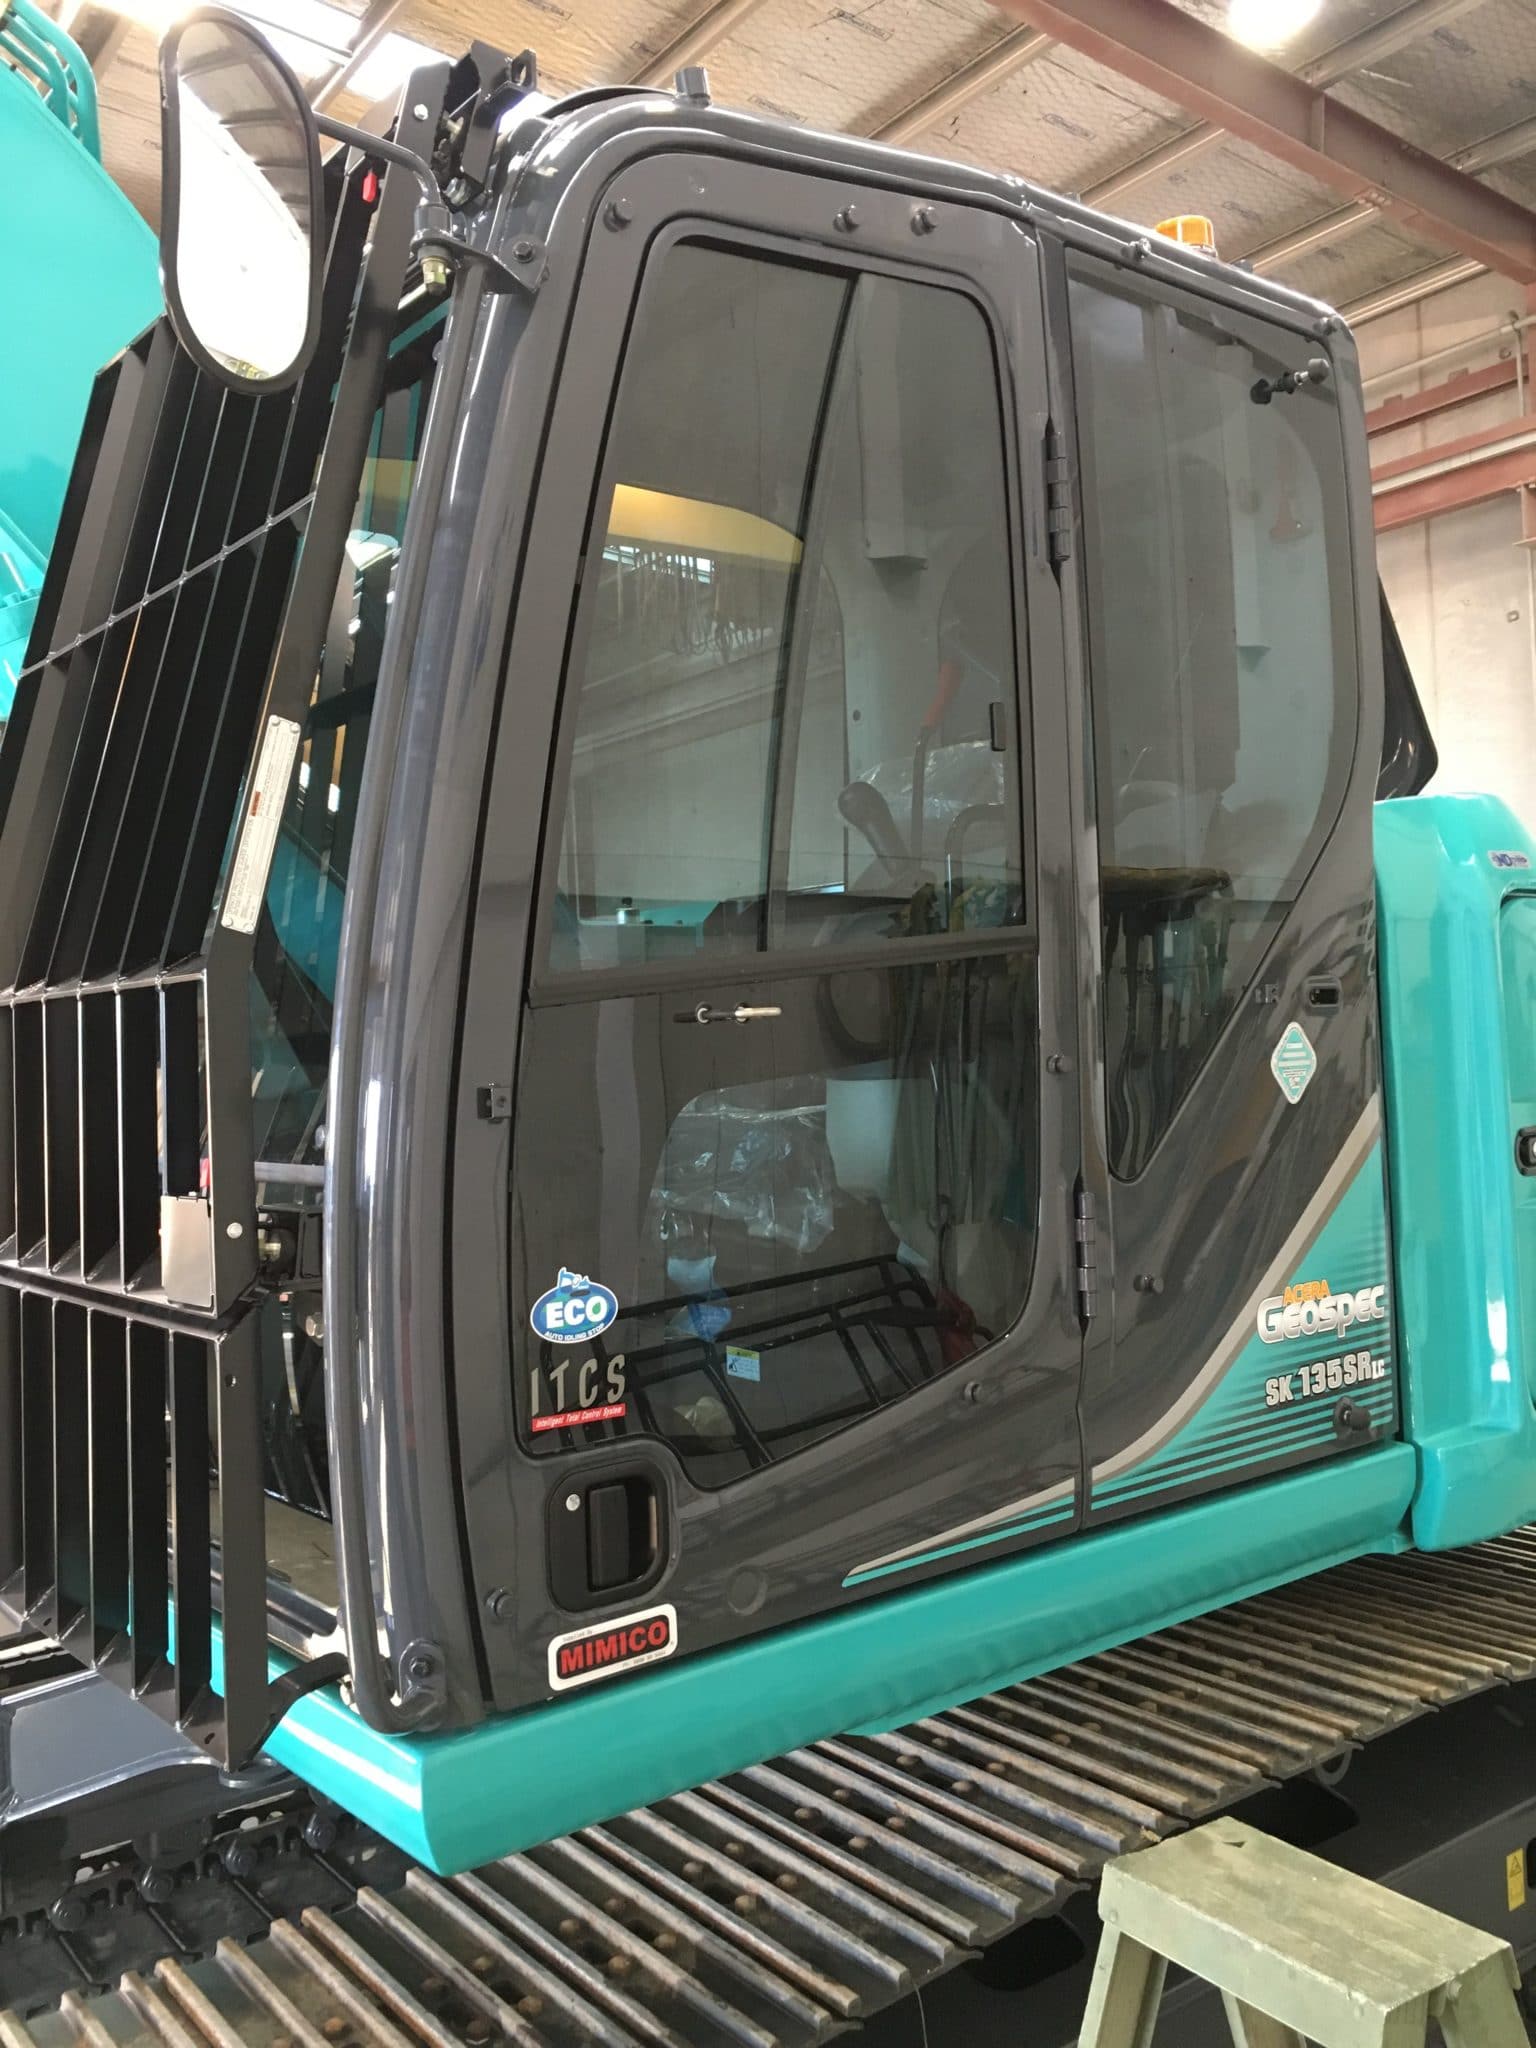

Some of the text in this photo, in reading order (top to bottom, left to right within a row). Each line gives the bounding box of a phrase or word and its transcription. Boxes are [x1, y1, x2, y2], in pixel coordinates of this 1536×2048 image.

[1282, 1280, 1331, 1307] ACERA
[545, 1295, 608, 1329] ECO
[544, 1331, 564, 1341] AUTO
[531, 1354, 626, 1417] ITCS
[1265, 1374, 1294, 1406] SK
[581, 1409, 601, 1420] Control
[602, 1406, 624, 1417] System
[560, 1620, 668, 1674] MIMICO
